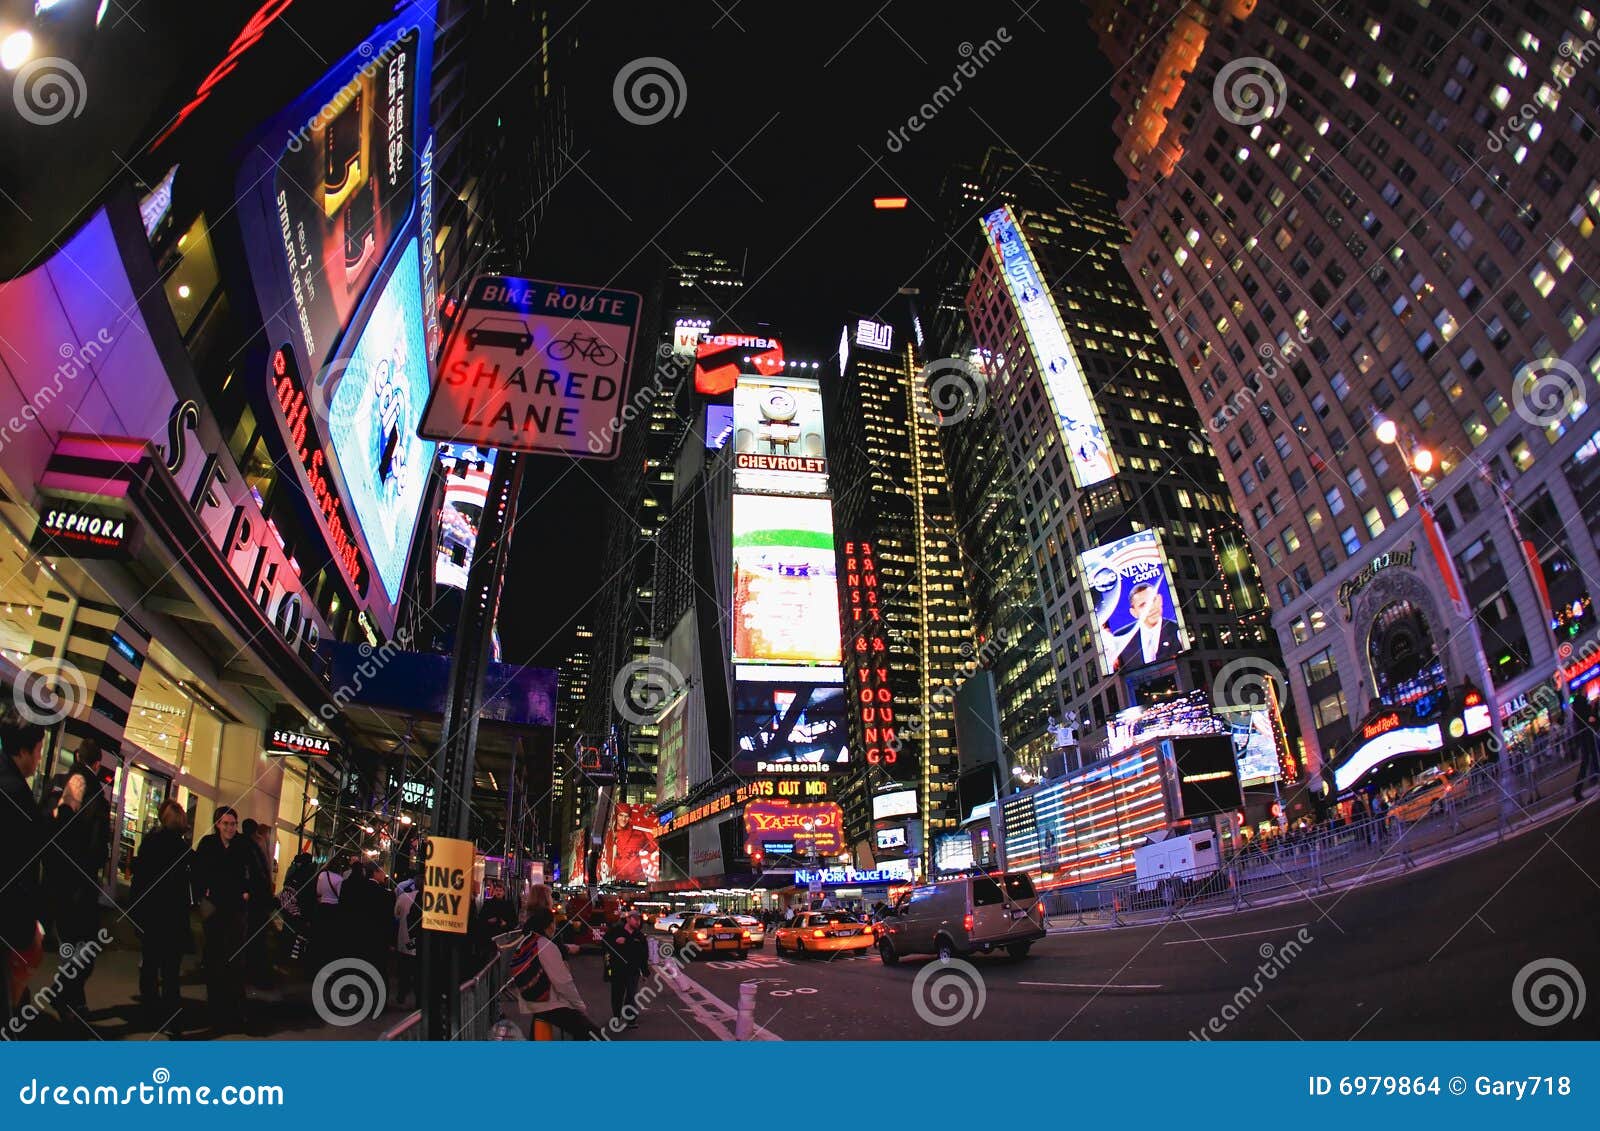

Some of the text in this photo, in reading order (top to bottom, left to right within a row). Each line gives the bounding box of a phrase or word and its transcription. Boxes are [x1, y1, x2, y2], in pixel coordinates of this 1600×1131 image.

[419, 135, 438, 362] WRIGLEY'S
[300, 254, 313, 269] 5
[277, 190, 315, 357] STIMULATE YOUR SENSES
[482, 284, 626, 316] BIKE ROUTE
[703, 334, 778, 349] TOSHIBA
[445, 360, 618, 402] SHARED
[461, 397, 581, 436] LANE
[738, 455, 825, 472] CHEVROLET
[45, 510, 124, 539] SEPHORA
[1132, 568, 1161, 584] .com
[845, 542, 862, 621] ERNST
[858, 668, 880, 764] YOUNG
[1364, 713, 1399, 738] Hard Rock
[273, 730, 330, 752] SEPHORA
[757, 761, 830, 772] Panasonic
[778, 781, 801, 796] OUT
[750, 811, 836, 831] YAHOO!
[818, 868, 846, 883] YORK
[847, 868, 880, 882] POLICE
[423, 891, 462, 916] DAY
